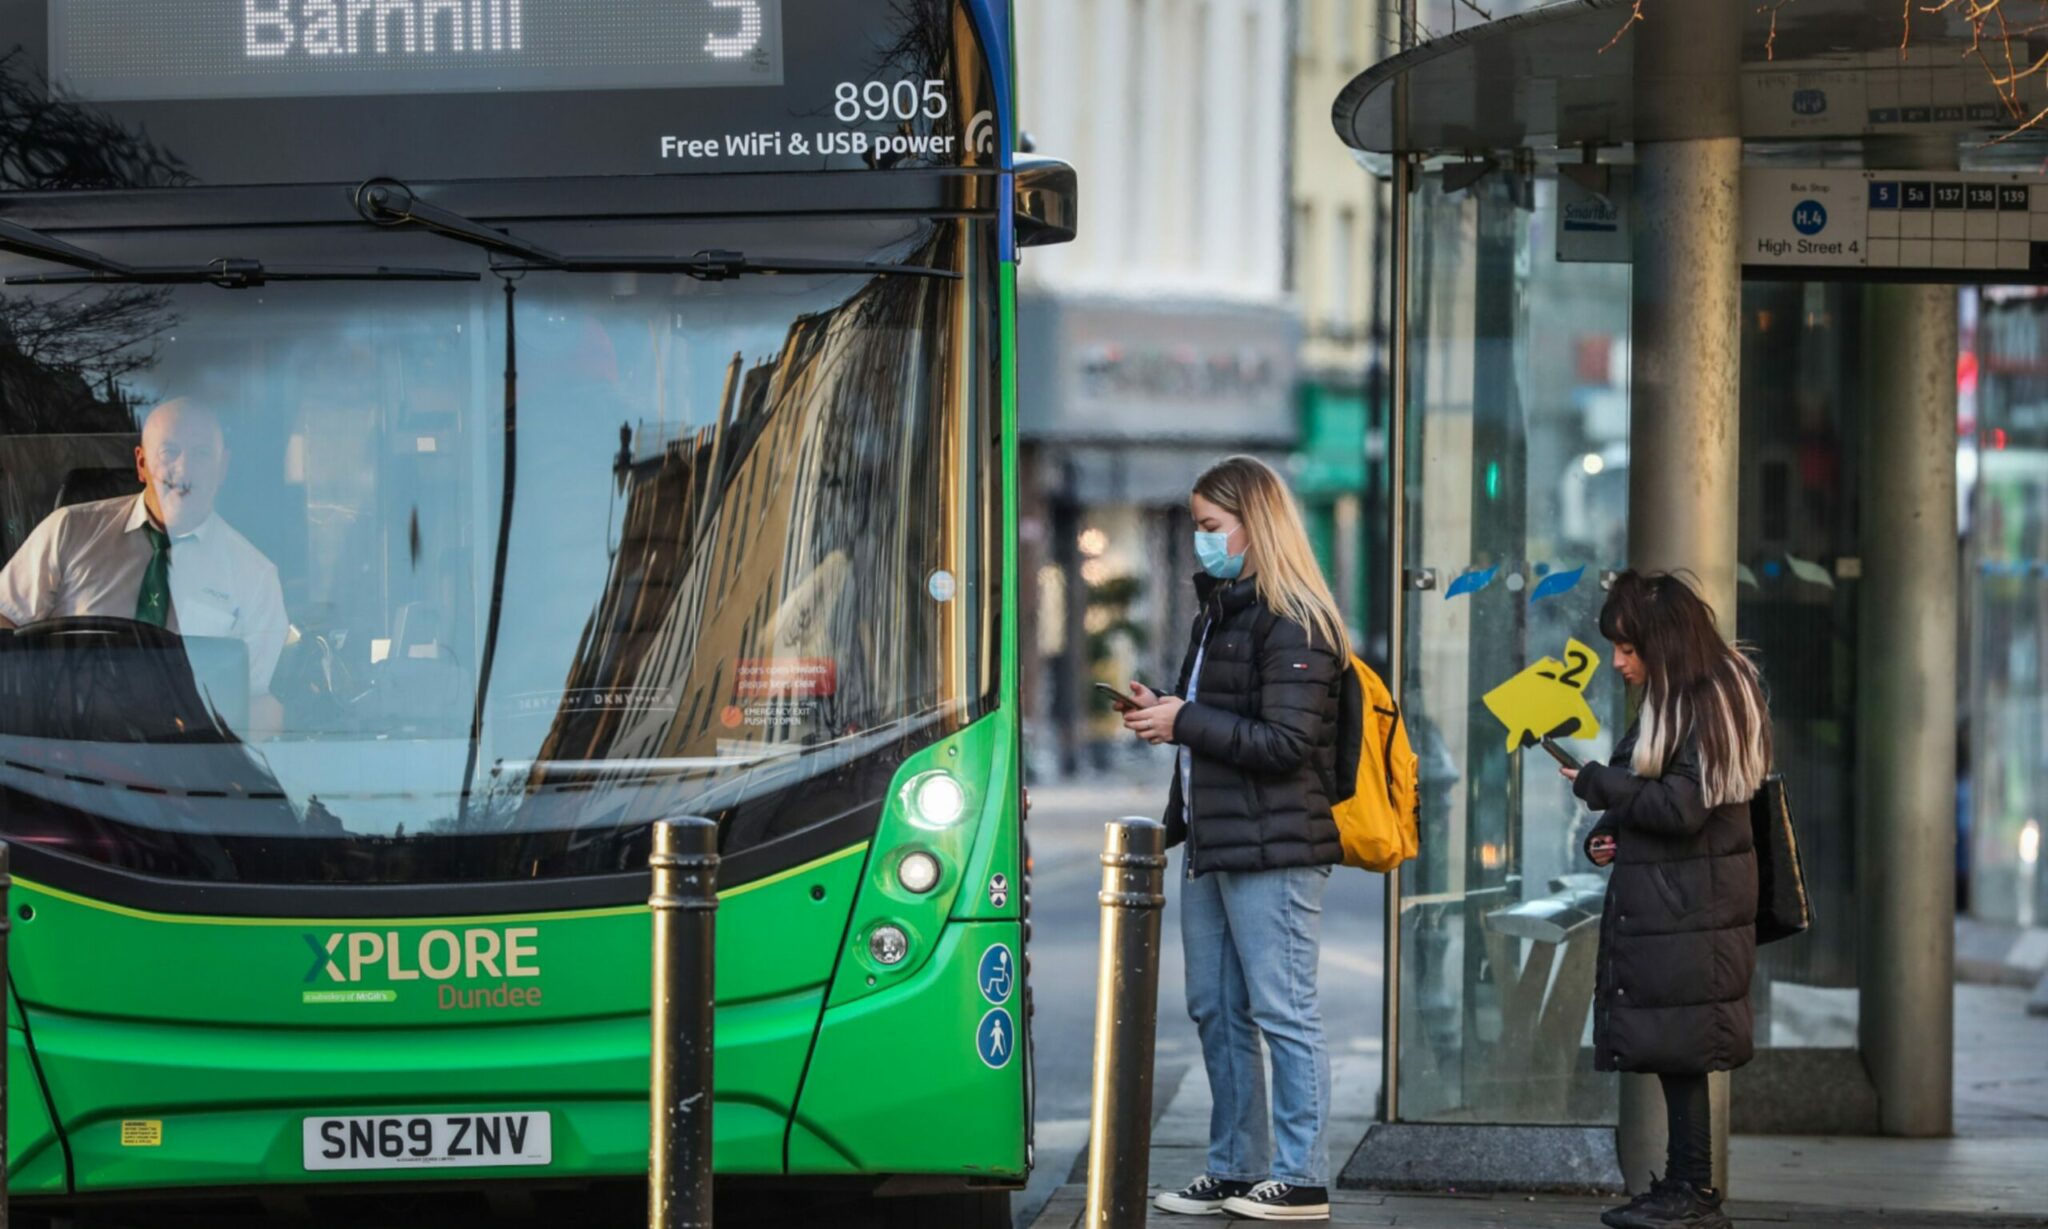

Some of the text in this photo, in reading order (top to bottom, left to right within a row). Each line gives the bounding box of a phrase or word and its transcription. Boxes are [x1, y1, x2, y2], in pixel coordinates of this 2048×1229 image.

[834, 79, 948, 122] 8905
[661, 131, 955, 159] Free WiFi & USB power
[1790, 182, 1807, 192] Bus
[1879, 187, 2026, 203] 5 5a 137 138 139
[1796, 209, 1822, 225] H.4
[1758, 239, 1859, 257] High Street 4
[1558, 650, 1588, 689] 2
[302, 927, 540, 983] XPLORE
[438, 982, 542, 1009] Dundee
[320, 1116, 529, 1159] SN69 ZNV
